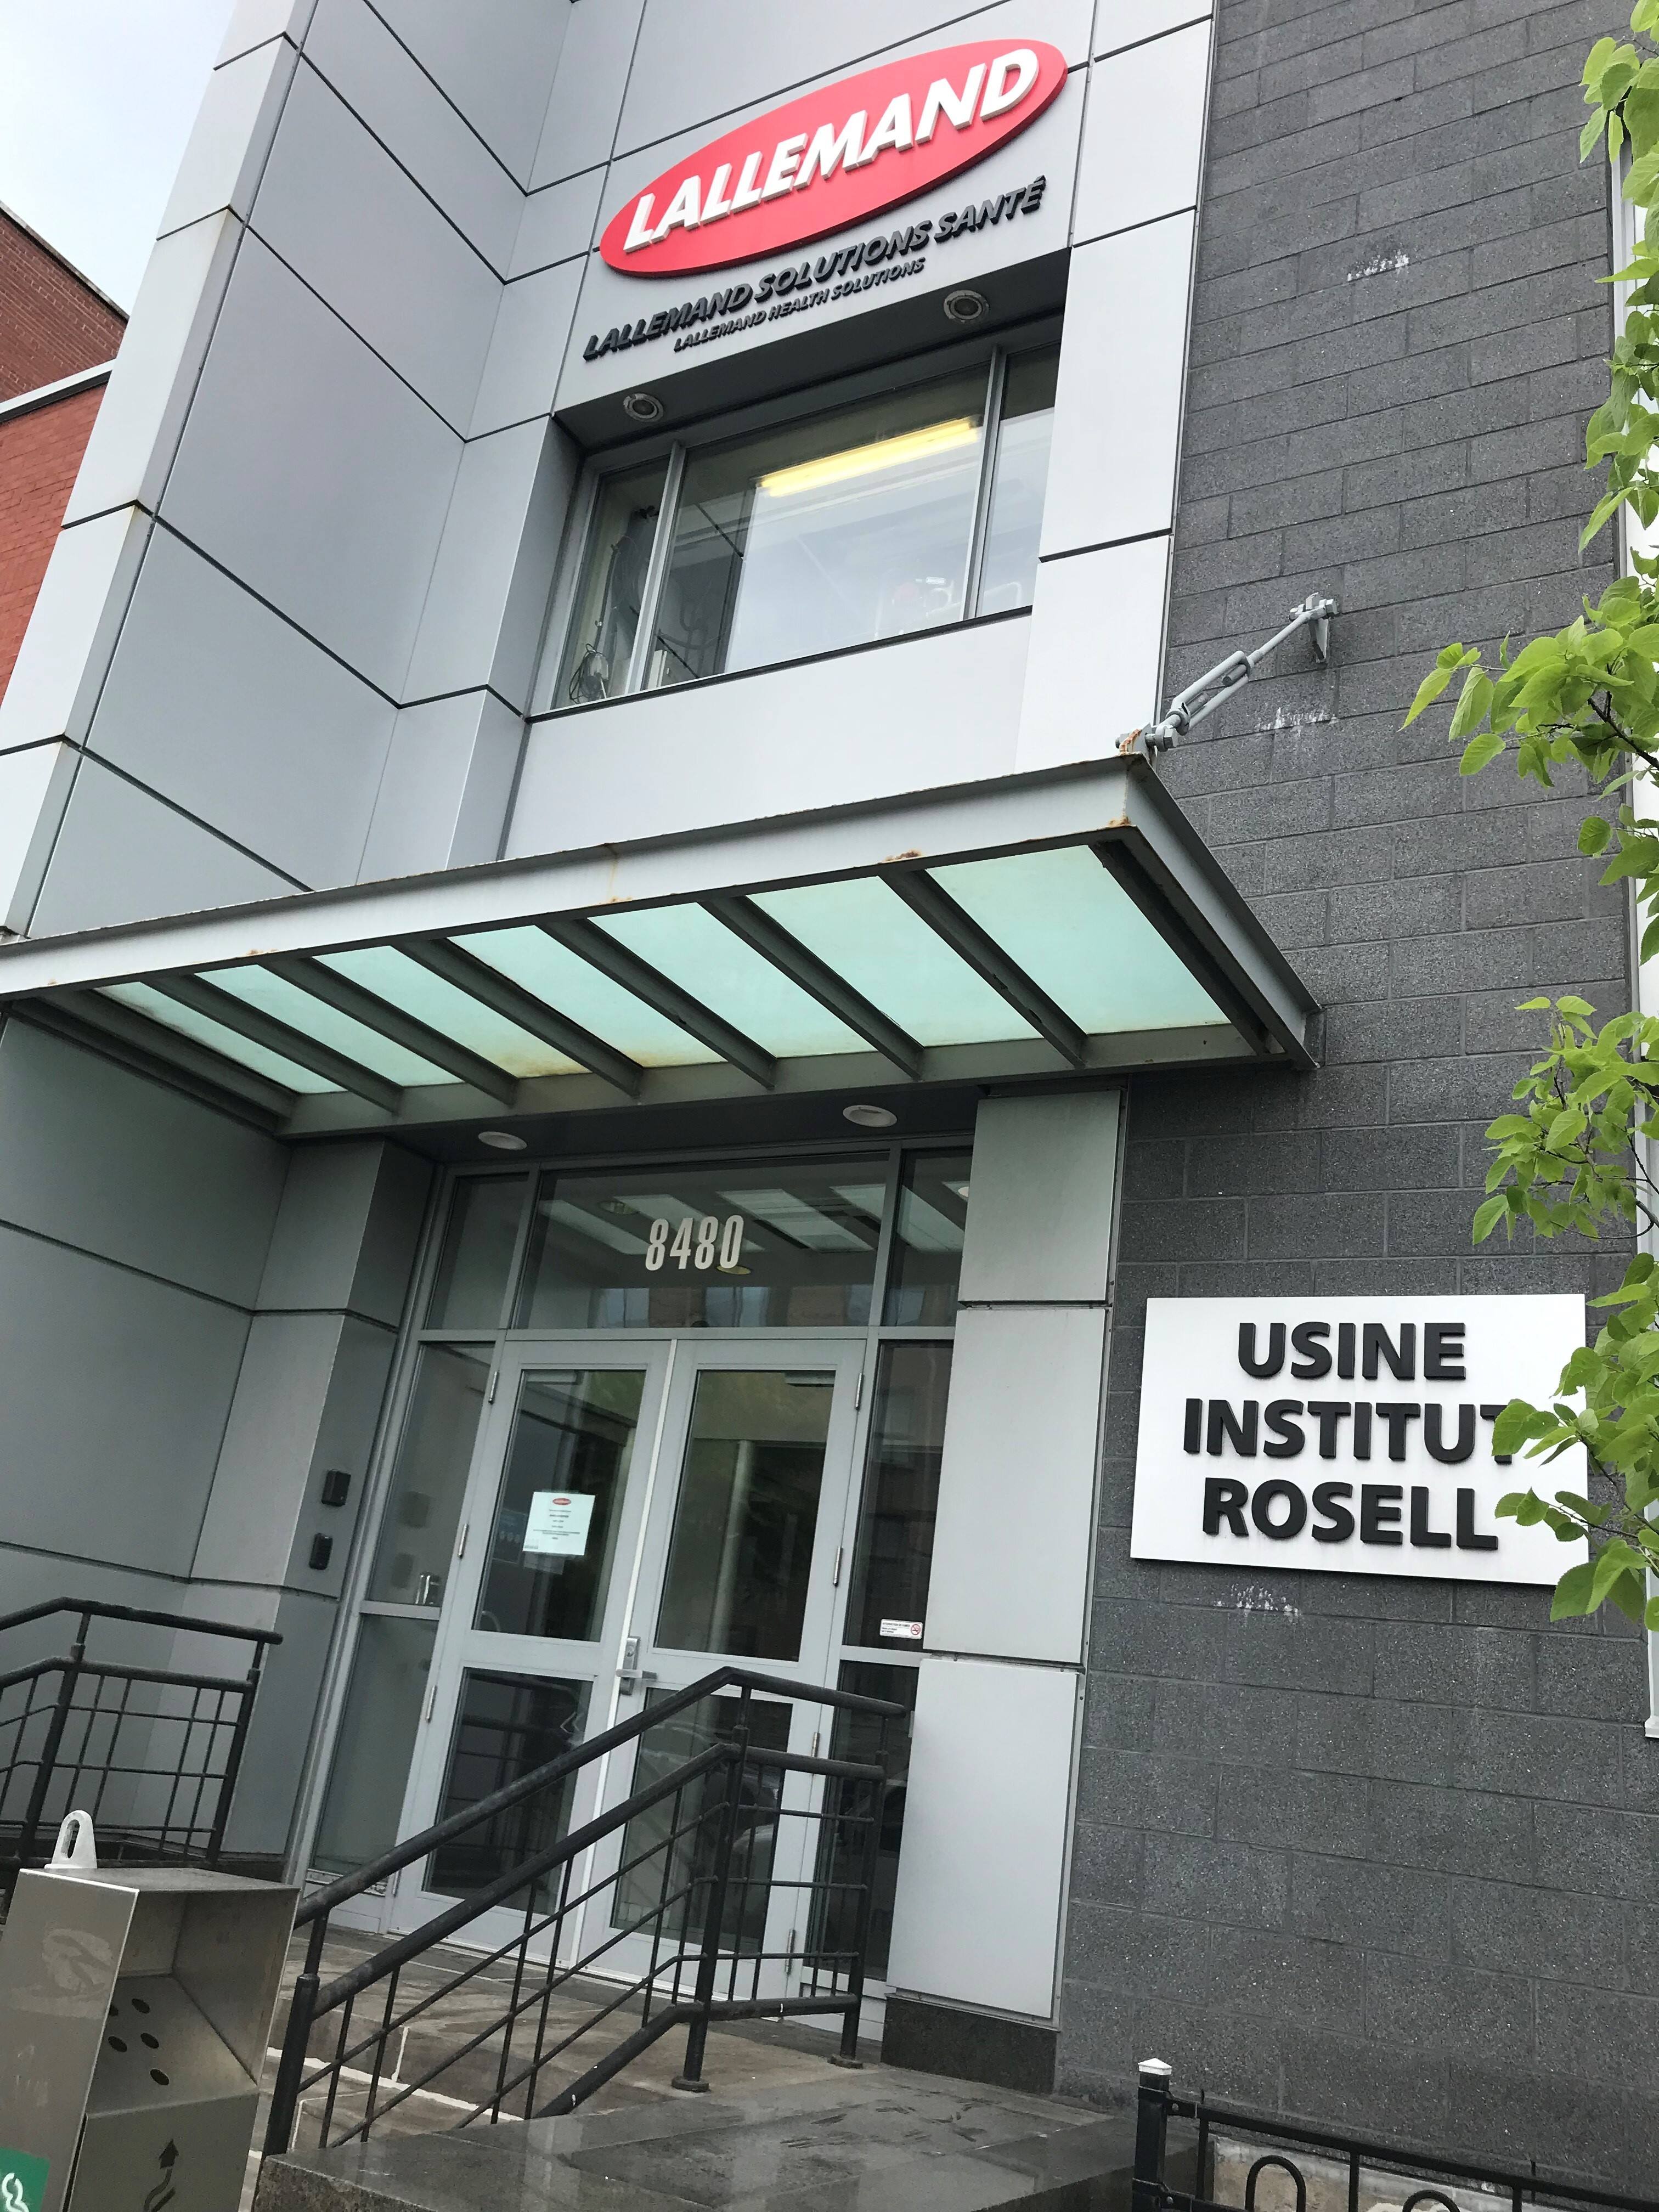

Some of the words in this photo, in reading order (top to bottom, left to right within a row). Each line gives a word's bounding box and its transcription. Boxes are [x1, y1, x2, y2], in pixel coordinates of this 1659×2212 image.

[623, 49, 1040, 253] LALLEMAND
[583, 283, 754, 361] LALLEMAND
[754, 219, 933, 303] SOLUTIONS
[934, 174, 1047, 244] SANTÉ
[674, 310, 768, 352] LALLEMAND
[768, 288, 829, 321] HEALTH
[831, 256, 926, 301] SOLUTIONS
[645, 1215, 744, 1271] 8480
[1238, 1321, 1467, 1381] USINE
[1203, 1477, 1498, 1551] ROSELL
